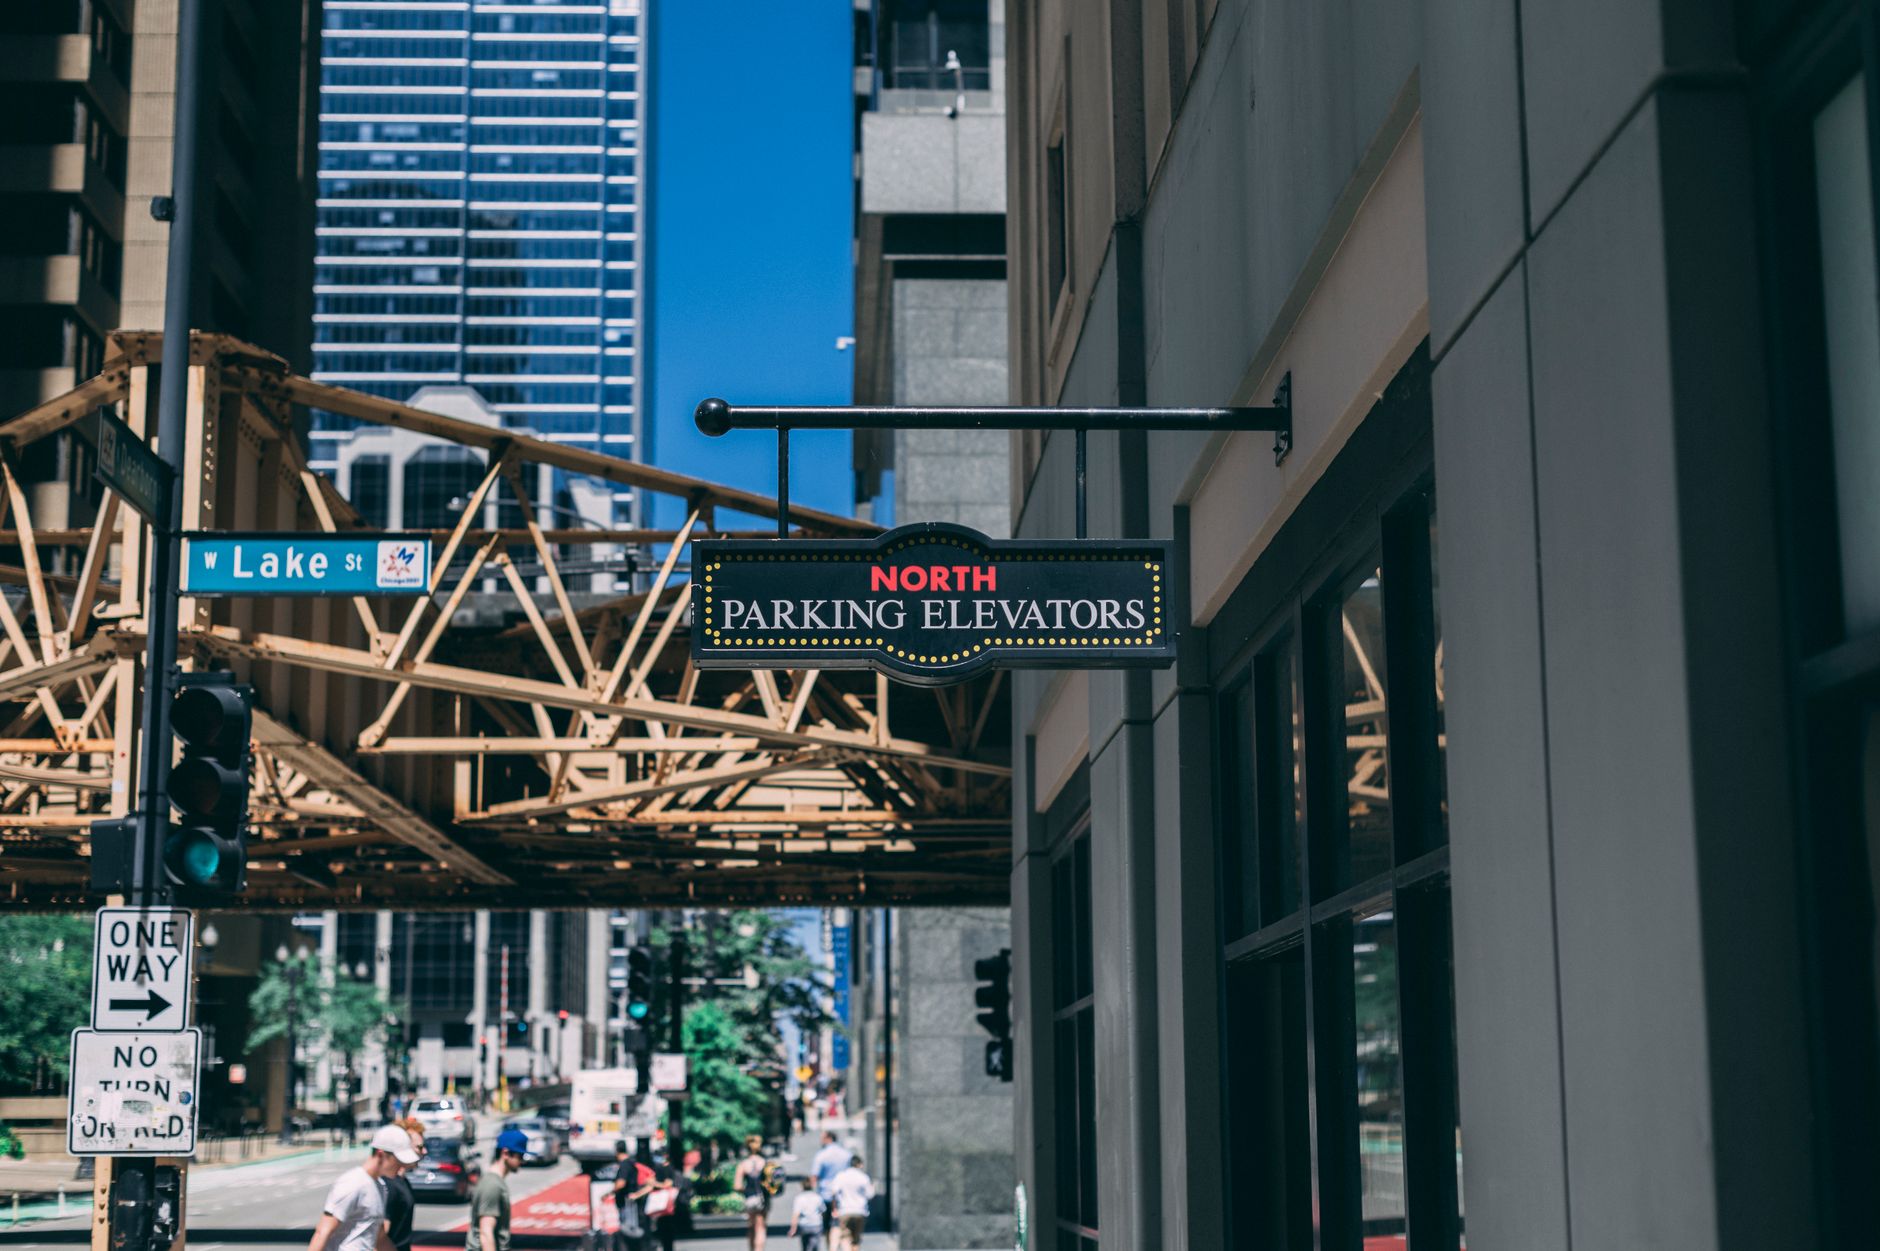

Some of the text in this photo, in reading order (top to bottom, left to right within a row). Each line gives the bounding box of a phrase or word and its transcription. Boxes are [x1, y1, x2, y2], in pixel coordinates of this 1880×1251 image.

[204, 545, 363, 579] W Lake St
[871, 565, 997, 592] NORTH
[721, 599, 1145, 630] PARKING ELEVATORS
[110, 921, 178, 948] ONE
[107, 955, 178, 982] WAY
[113, 1046, 158, 1068] NO
